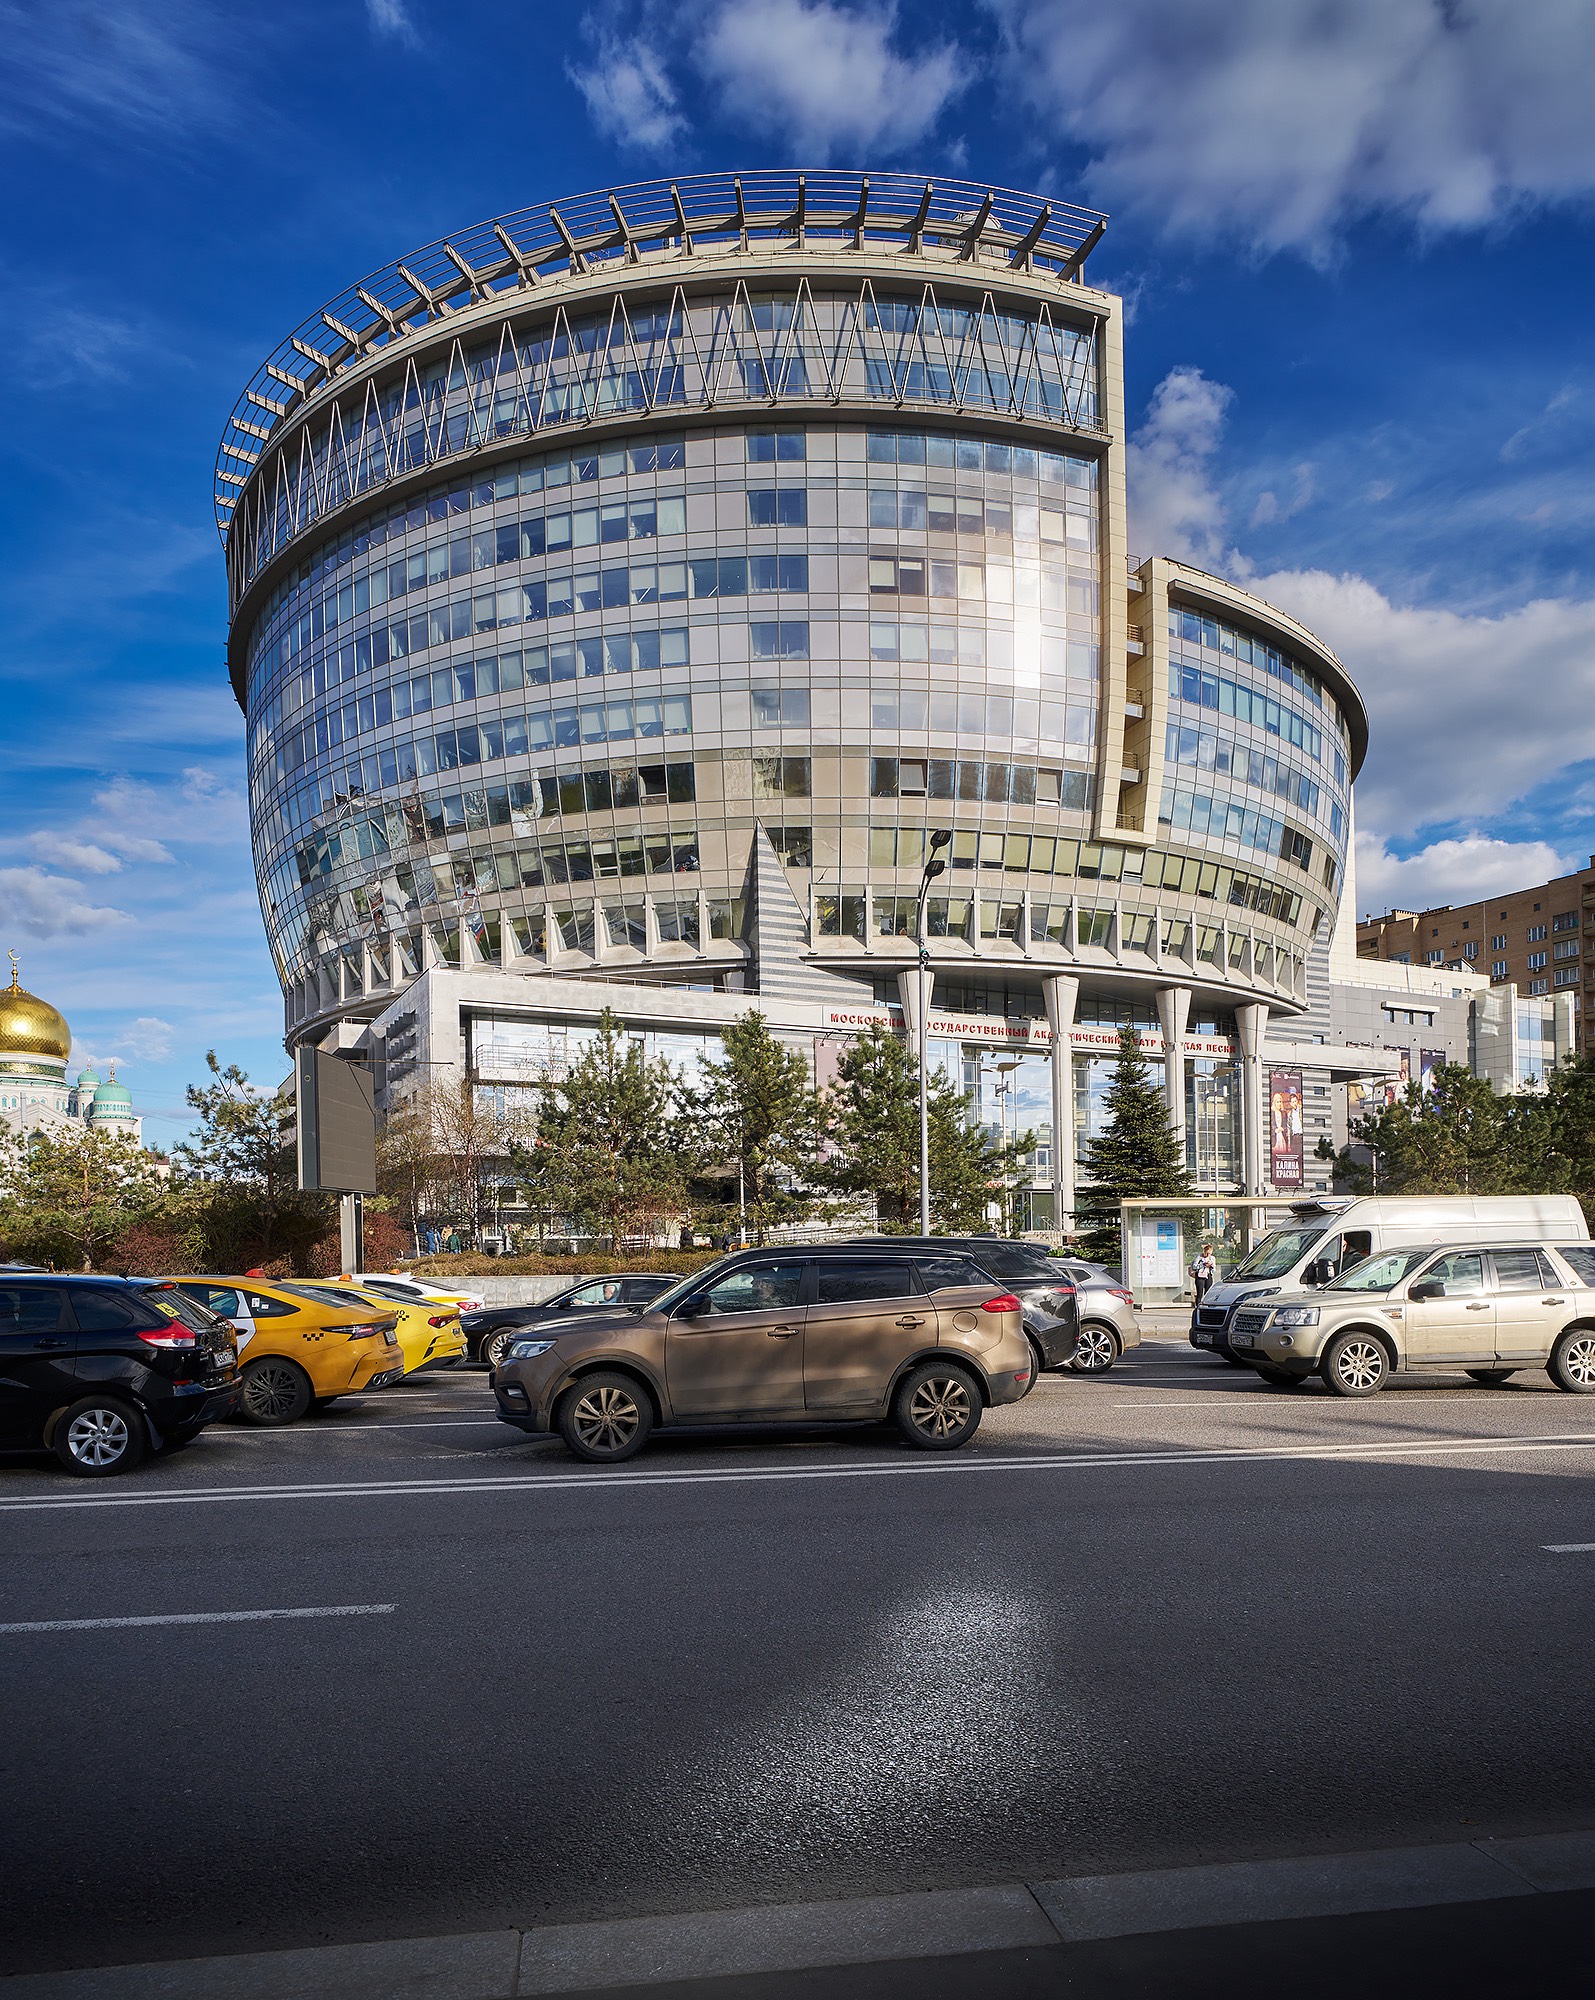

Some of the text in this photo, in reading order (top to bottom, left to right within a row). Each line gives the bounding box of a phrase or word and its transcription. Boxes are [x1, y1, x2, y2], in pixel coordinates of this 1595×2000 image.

[831, 1013, 906, 1028] МОСКОВСКИ
[1133, 1037, 1157, 1048] ЕАТР
[1206, 1043, 1236, 1054] ПЕСНЯ
